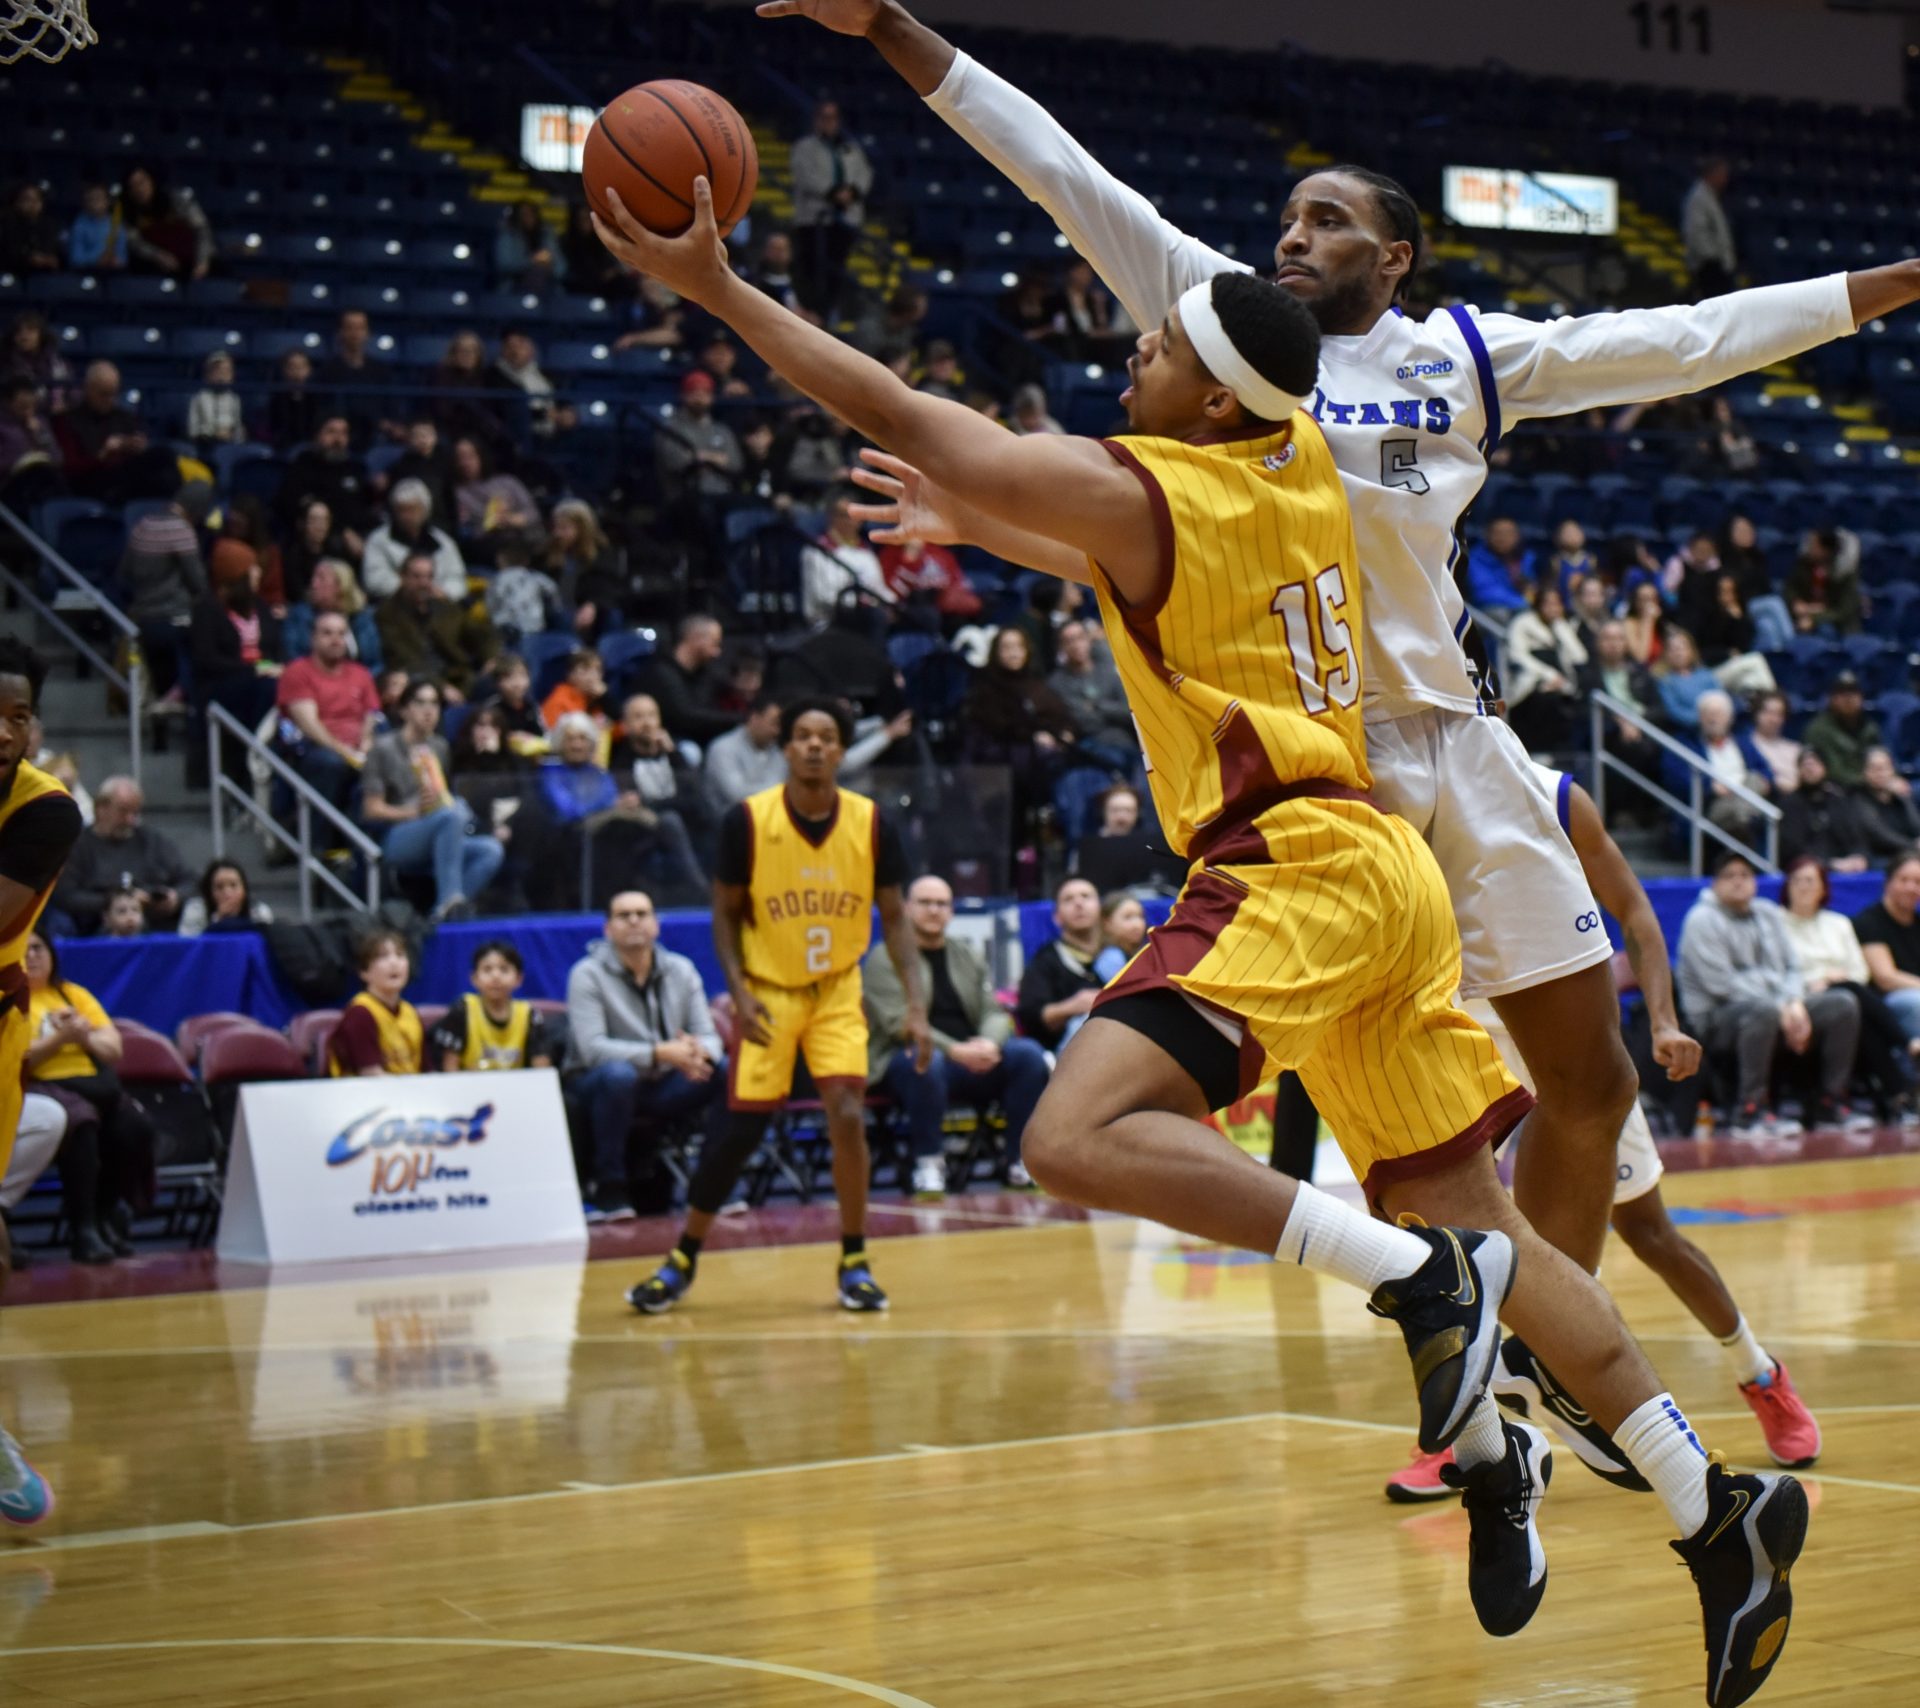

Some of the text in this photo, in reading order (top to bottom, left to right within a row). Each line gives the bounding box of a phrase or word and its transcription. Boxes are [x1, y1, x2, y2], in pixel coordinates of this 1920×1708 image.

[1629, 2, 1710, 54] 111
[1396, 360, 1453, 380] OXFORD
[1312, 386, 1451, 435] ITANS
[1381, 438, 1430, 496] 5
[1269, 562, 1361, 716] 15
[805, 925, 833, 975] 2
[325, 1102, 495, 1167] Coast
